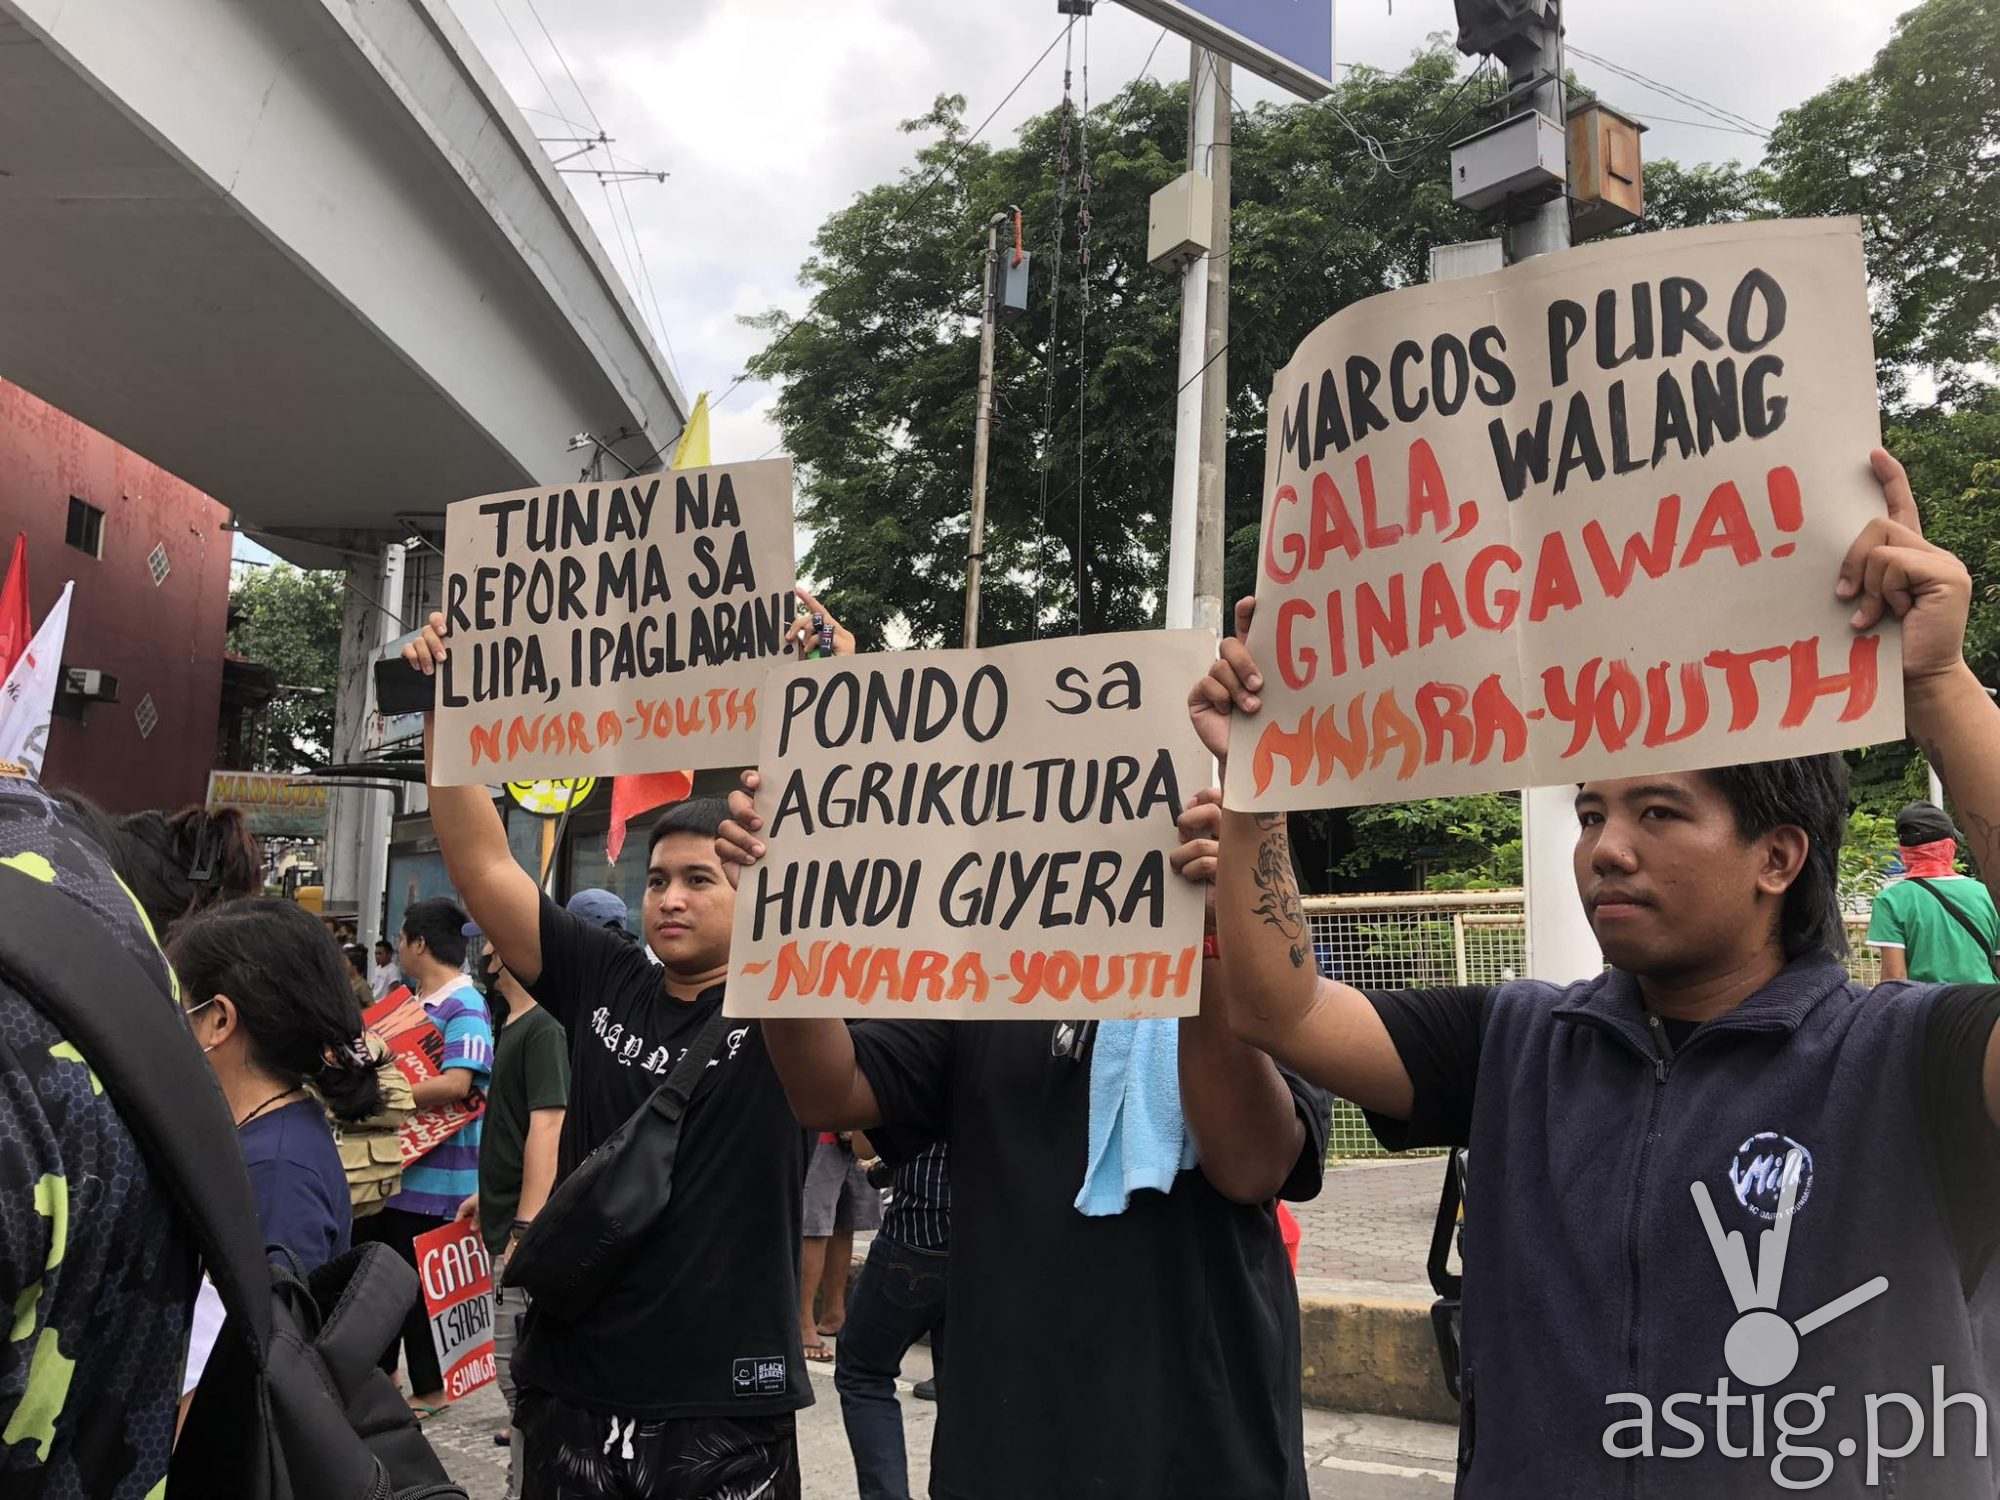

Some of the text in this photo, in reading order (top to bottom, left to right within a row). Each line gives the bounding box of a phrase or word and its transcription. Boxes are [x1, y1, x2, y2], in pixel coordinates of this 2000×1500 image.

[1276, 267, 1787, 481] MARCOS PURO
[479, 473, 740, 557] TUNAY NA
[1264, 355, 1788, 584] GALA, WALANG
[447, 531, 755, 637] REPORMA SA
[1276, 465, 1803, 690] GINAGAWA!
[442, 591, 795, 707] LUPA, IPAGLABAN!
[470, 688, 757, 766] NNARA-YOUTH
[779, 660, 1141, 757] PONDO sa
[1253, 634, 1880, 799] NNARA-YOUTH
[769, 749, 1183, 838] AGRIKULTURA
[752, 850, 1165, 941] HINDI GIYERA
[463, 1032, 486, 1064] 10
